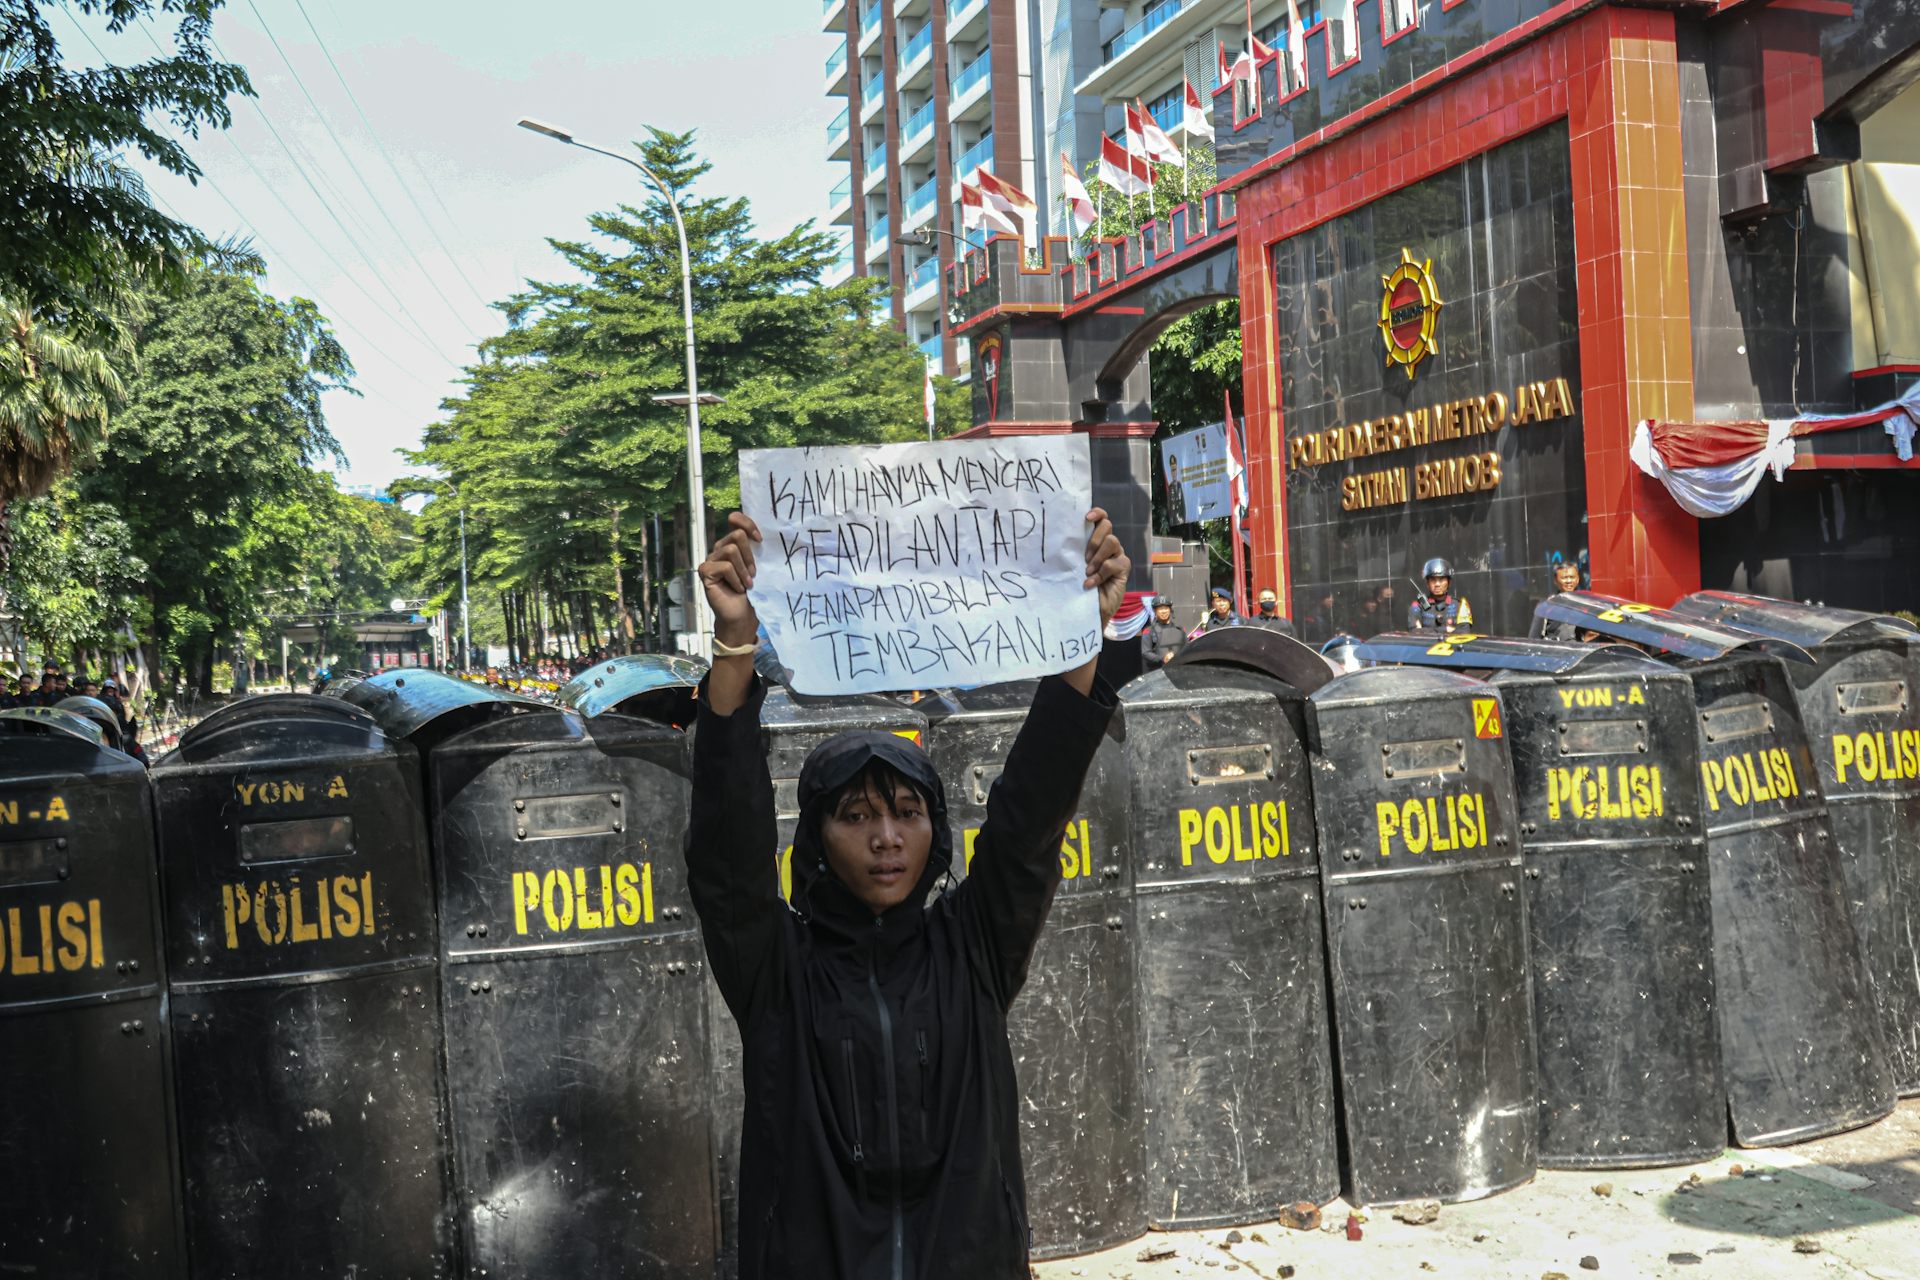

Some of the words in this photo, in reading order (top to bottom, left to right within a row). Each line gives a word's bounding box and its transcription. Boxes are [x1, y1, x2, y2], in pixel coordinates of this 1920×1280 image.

[1289, 427, 1345, 470] POLRI
[1345, 407, 1430, 459] DAERAH
[1432, 392, 1508, 441] METRO
[1510, 377, 1575, 426] JAYA
[770, 464, 849, 524] KAMI
[853, 462, 938, 513] HANYA
[937, 451, 1063, 500] MENCARI
[1342, 467, 1408, 511] SATUAN
[1415, 452, 1503, 500] BRIMOB
[958, 500, 1046, 566] TAPI
[786, 584, 894, 632] KENAPA
[893, 570, 1028, 622] DIBALAS
[1476, 703, 1485, 720] A
[1488, 718, 1500, 736] 43
[237, 780, 305, 805] YON
[1547, 765, 1663, 820] POLISI
[1701, 747, 1799, 811] POLISI
[1178, 799, 1290, 867] POLISI
[1376, 792, 1488, 857] POLISI
[222, 871, 376, 950] POLISI
[511, 861, 655, 936] POLISI
